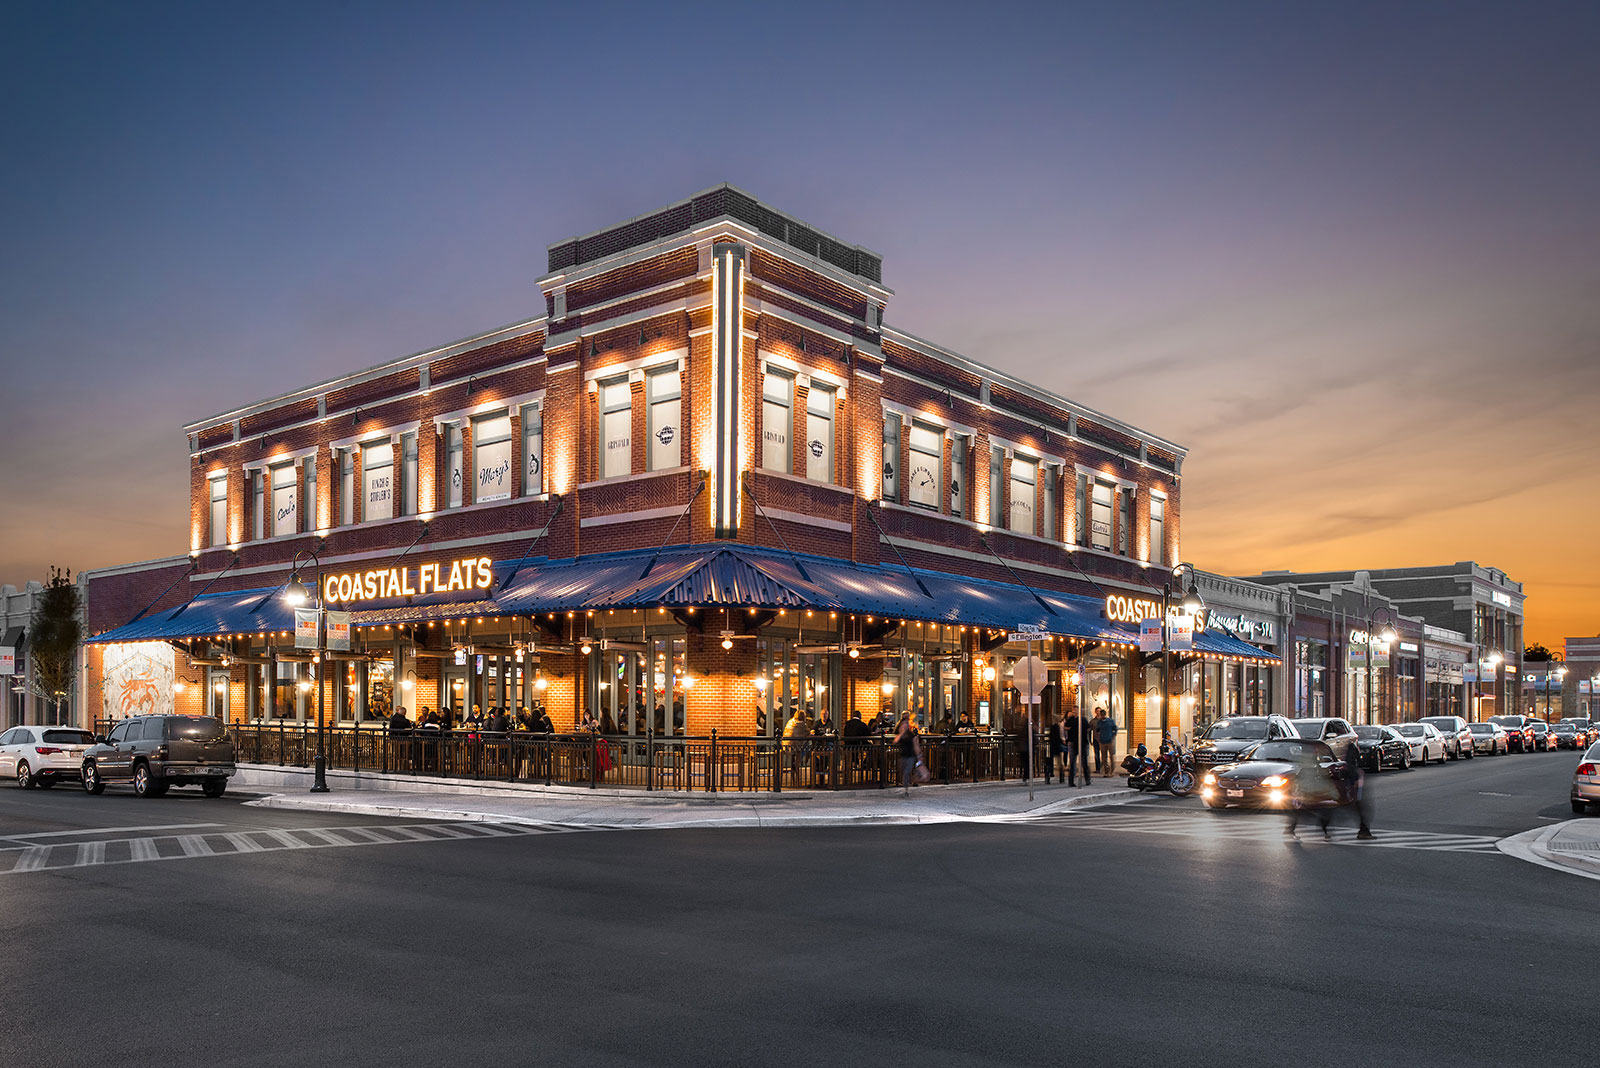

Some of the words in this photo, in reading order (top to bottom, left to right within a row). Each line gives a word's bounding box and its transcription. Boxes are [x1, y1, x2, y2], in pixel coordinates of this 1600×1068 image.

[479, 459, 509, 486] Mary's
[326, 566, 416, 603] COASTAL
[420, 556, 492, 594] FLATS
[1015, 633, 1043, 641] Ellington
